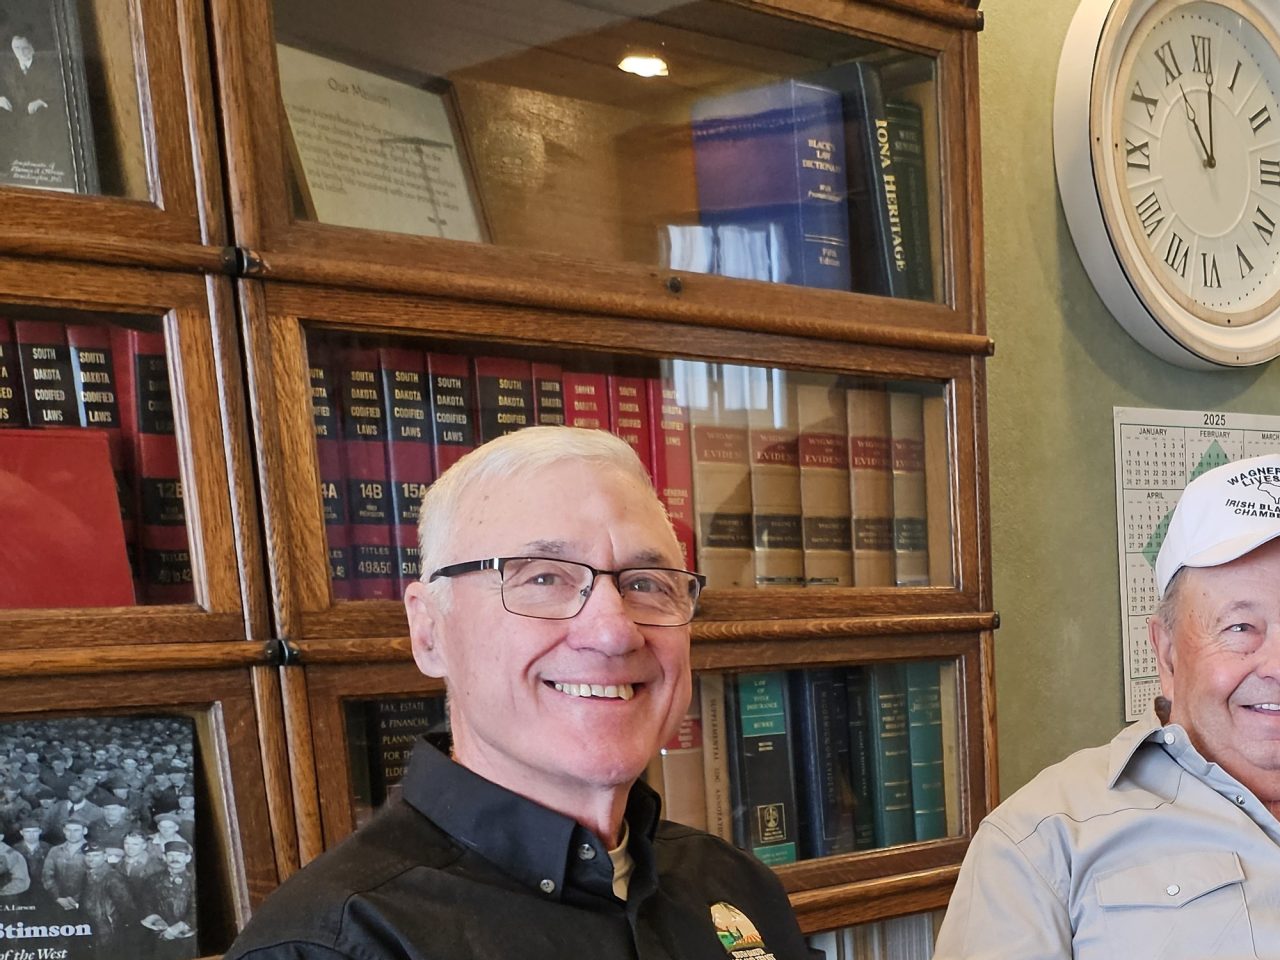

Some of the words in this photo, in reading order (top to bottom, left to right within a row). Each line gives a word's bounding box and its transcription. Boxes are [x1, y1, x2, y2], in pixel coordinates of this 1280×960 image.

[875, 118, 891, 169] IONA
[883, 174, 907, 272] HERITAGE
[33, 348, 56, 360] SOUTH
[80, 352, 105, 364] SOUTH
[33, 368, 61, 380] DAKOTA
[80, 372, 110, 384] DAKOTA
[351, 371, 374, 383] SOUTH
[395, 371, 419, 383] SOUTH
[437, 377, 461, 389] SOUTH
[499, 379, 522, 390] SOUTH
[34, 389, 65, 400] CODIFIED
[81, 391, 114, 403] CODIFIED
[351, 388, 377, 400] DAKOTA
[394, 389, 421, 401] DAKOTA
[436, 395, 464, 407] DAKOTA
[498, 396, 525, 408] DAKOTA
[43, 409, 63, 421] LAWS
[89, 411, 112, 422] LAWS
[351, 406, 381, 418] CODIFIED
[394, 407, 424, 420] CODIFIED
[436, 412, 467, 425] CODIFIED
[497, 413, 527, 425] CODIFIED
[1204, 414, 1226, 426] 2025
[356, 425, 378, 436] LAWS
[401, 426, 421, 438] LAWS
[443, 431, 463, 442] LAWS
[1139, 428, 1167, 436] JANUARY
[1200, 430, 1231, 439] FEBRUARY
[320, 483, 338, 499] 4A
[360, 483, 383, 499] 14B
[1225, 499, 1255, 510] IRISH
[389, 718, 429, 728] FINANCIAL
[382, 735, 417, 745] PLANNIN
[384, 751, 399, 761] FOR
[14, 949, 35, 960] the
[37, 948, 68, 960] West
